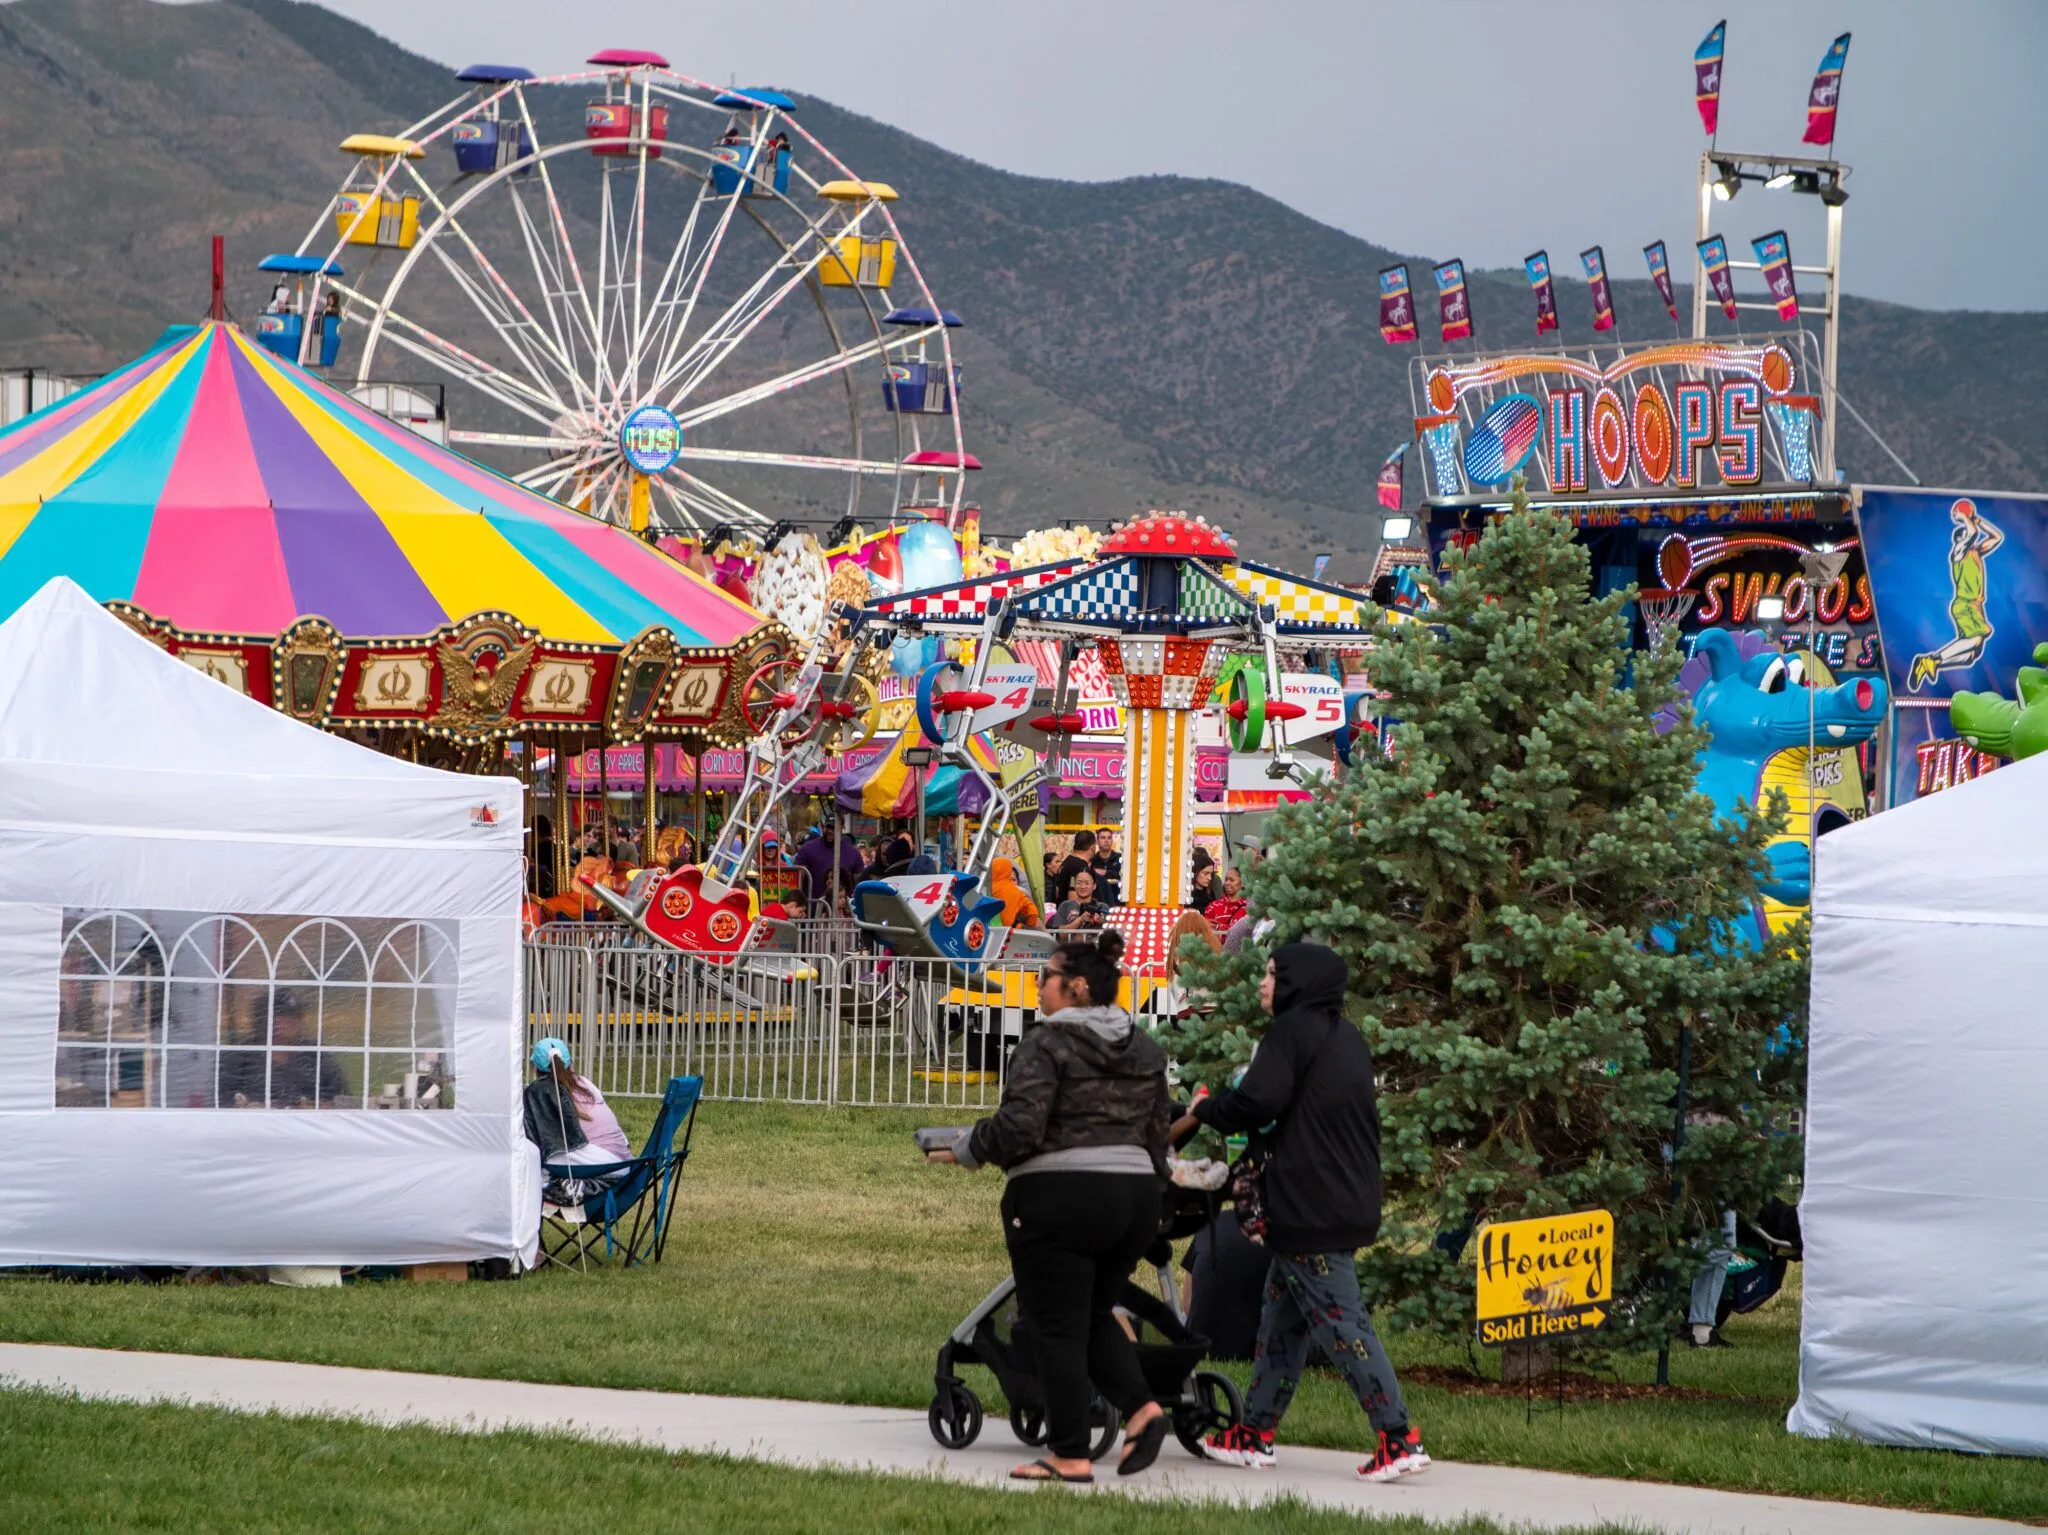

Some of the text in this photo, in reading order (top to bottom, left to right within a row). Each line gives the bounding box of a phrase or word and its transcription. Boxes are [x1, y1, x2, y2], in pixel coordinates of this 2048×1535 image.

[1550, 378, 1762, 494] HOOPS
[1741, 501, 1765, 521] ONE
[1697, 573, 1873, 625] SWOOS
[984, 675, 1036, 683] SKYRACE
[1284, 685, 1341, 695] SKYRACE
[1000, 687, 1029, 709] 4
[1315, 699, 1342, 721] 5
[586, 753, 616, 772] CADY
[701, 752, 745, 773] ORN DO
[998, 743, 1025, 765] PASS
[1814, 761, 1844, 787] PASS
[913, 882, 944, 905] 4
[1550, 1223, 1593, 1244] Local
[1480, 1230, 1610, 1299] Honey
[1483, 1311, 1579, 1344] Sold Here
